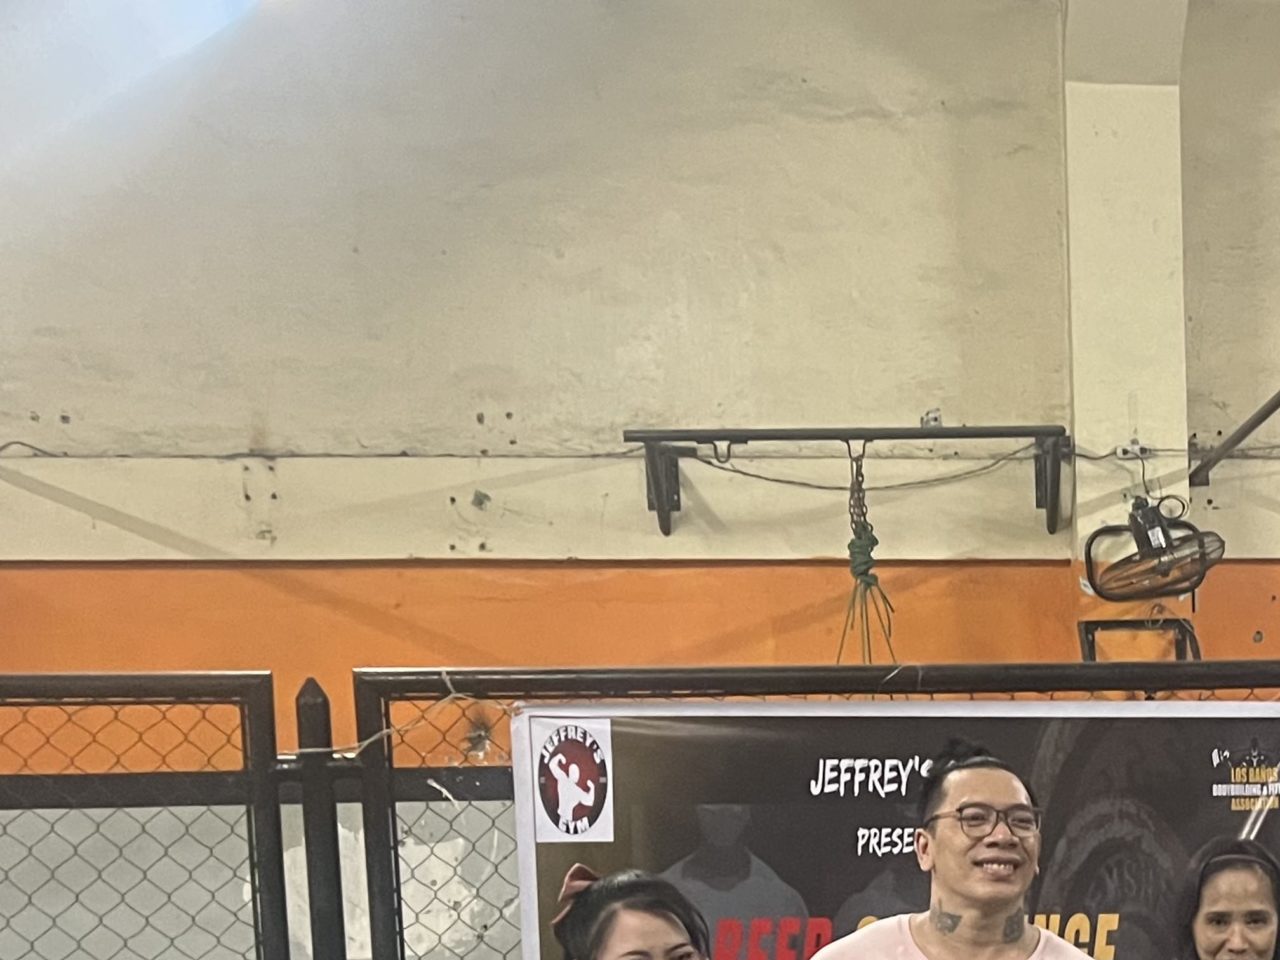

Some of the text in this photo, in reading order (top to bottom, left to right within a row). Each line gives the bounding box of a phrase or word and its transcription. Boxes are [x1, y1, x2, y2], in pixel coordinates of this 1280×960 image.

[541, 725, 605, 764] JEFFREY'S
[1231, 767, 1247, 782] LOS
[558, 816, 592, 835] GYM
[857, 827, 915, 857] PRESE
